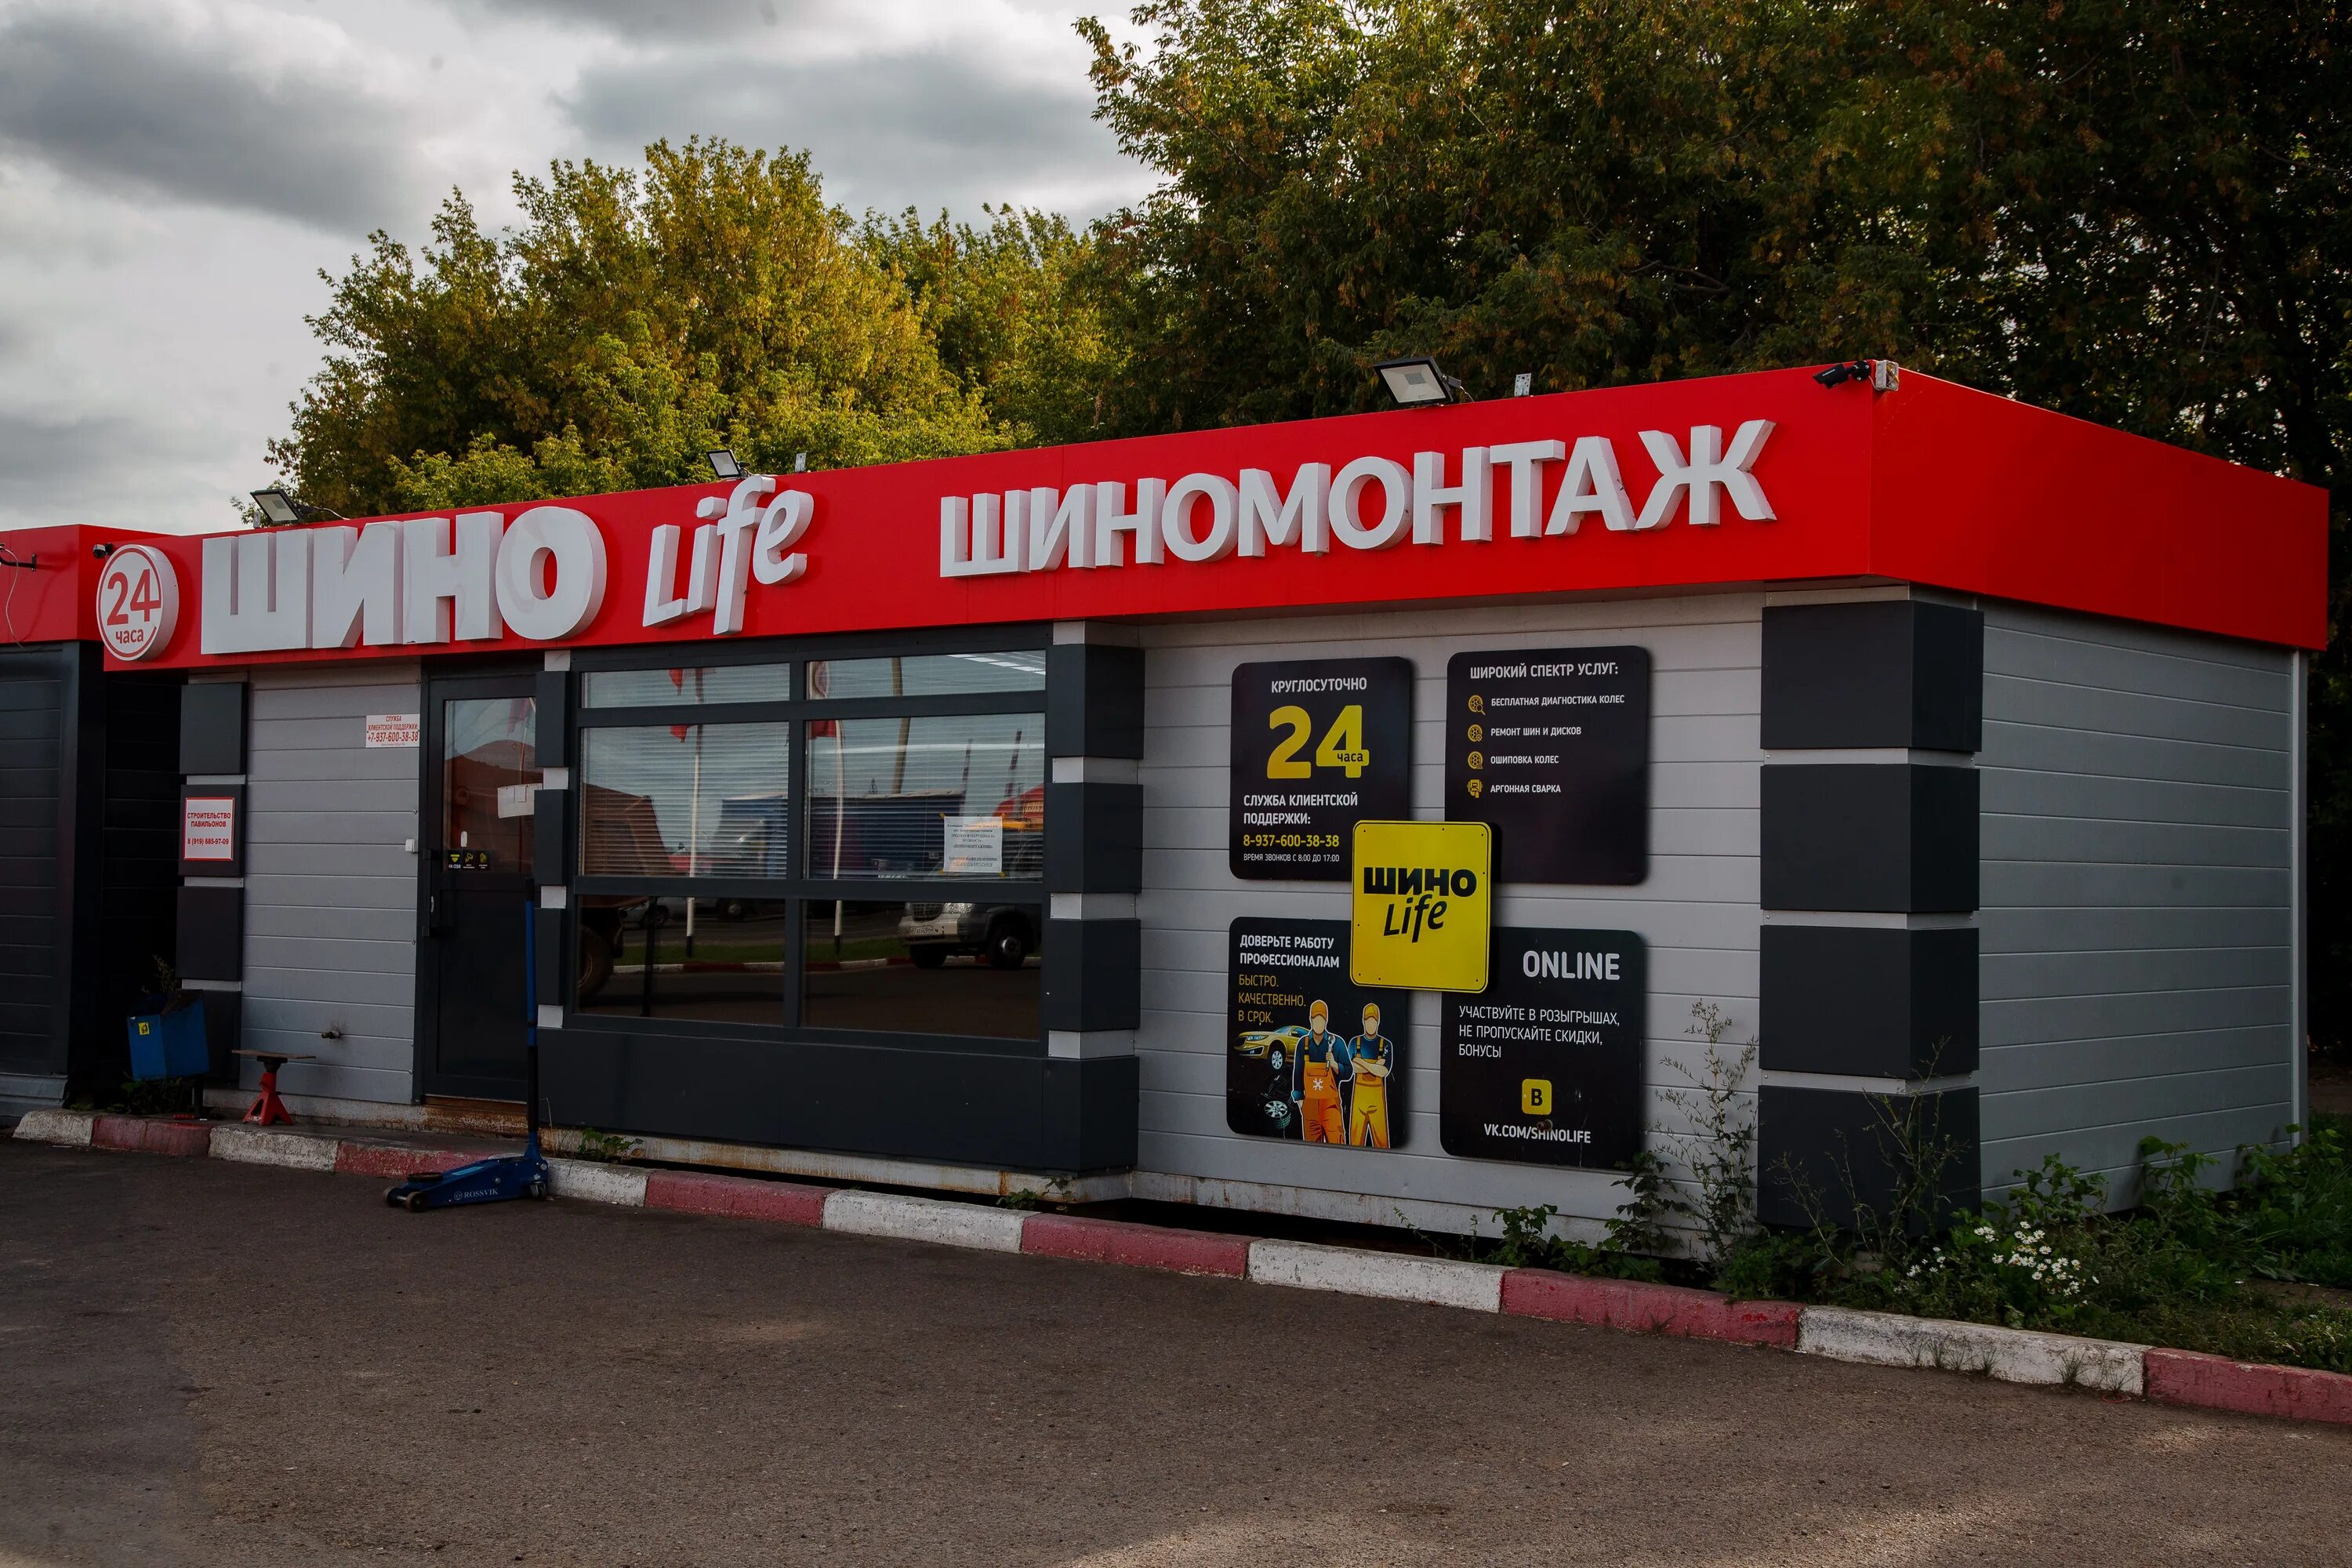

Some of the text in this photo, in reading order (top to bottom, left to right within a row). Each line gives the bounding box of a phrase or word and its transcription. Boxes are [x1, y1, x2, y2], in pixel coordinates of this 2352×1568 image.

[940, 419, 1777, 579] ШИНОМОНТАЖ
[201, 476, 815, 655] ШИНО Life
[107, 568, 162, 626] 24
[115, 628, 144, 644] часа
[1470, 662, 1619, 679] ШИРОКИЙ СПЕКТР УСЛУГ:
[1271, 677, 1367, 693] КРУГЛОСУТОЧНО
[1491, 695, 1625, 706] БЕСПЛАТНАЯ ДИАГНОСТИКА КОЛЕС
[368, 731, 419, 742] +7-937-600-38-38
[1490, 728, 1521, 736] РЕМОНТ
[1551, 727, 1581, 736] ДИСКОВ
[1267, 705, 1370, 779] 24
[1337, 753, 1363, 762] часа
[1490, 755, 1559, 764] ОШИПОВКА КОЛЕС
[1490, 784, 1561, 793] АРГОННАЯ СВАРКА
[1243, 791, 1358, 806] СЛУЖБА КЛИЕНТСКОЙ
[1243, 812, 1311, 826] ПОДДЕРЖКИ:
[1243, 834, 1340, 847] 8-937-600-38-38
[1243, 853, 1263, 862] ВРЕМЯ
[1265, 853, 1291, 862] ЗВОНКОВ
[1312, 854, 1321, 863] ДО
[1363, 866, 1477, 898] ШИНО
[1383, 894, 1447, 943] Life
[1240, 935, 1334, 949] ДОВЕРЬТЕ РАБОТУ
[1240, 953, 1340, 968] ПРОФЕССИОНАЛАМ
[1523, 950, 1621, 980] ONLINE
[1239, 974, 1279, 987] БЫСТРО.
[1238, 993, 1306, 1007] КАЧЕСТВЕННО.
[1238, 1010, 1274, 1023] В СРОК.
[1459, 1005, 1620, 1027] УЧАСТВУЙТЕ В РОЗЫГРЫШАХ,
[1459, 1024, 1603, 1046] НЕ ПРОПУСКАЙТЕ СКИДКИ,
[1459, 1044, 1501, 1058] БОНУСЫ
[1483, 1123, 1592, 1144] VK.COM/SHINOLIFE
[463, 1188, 499, 1199] ROSSVIK
